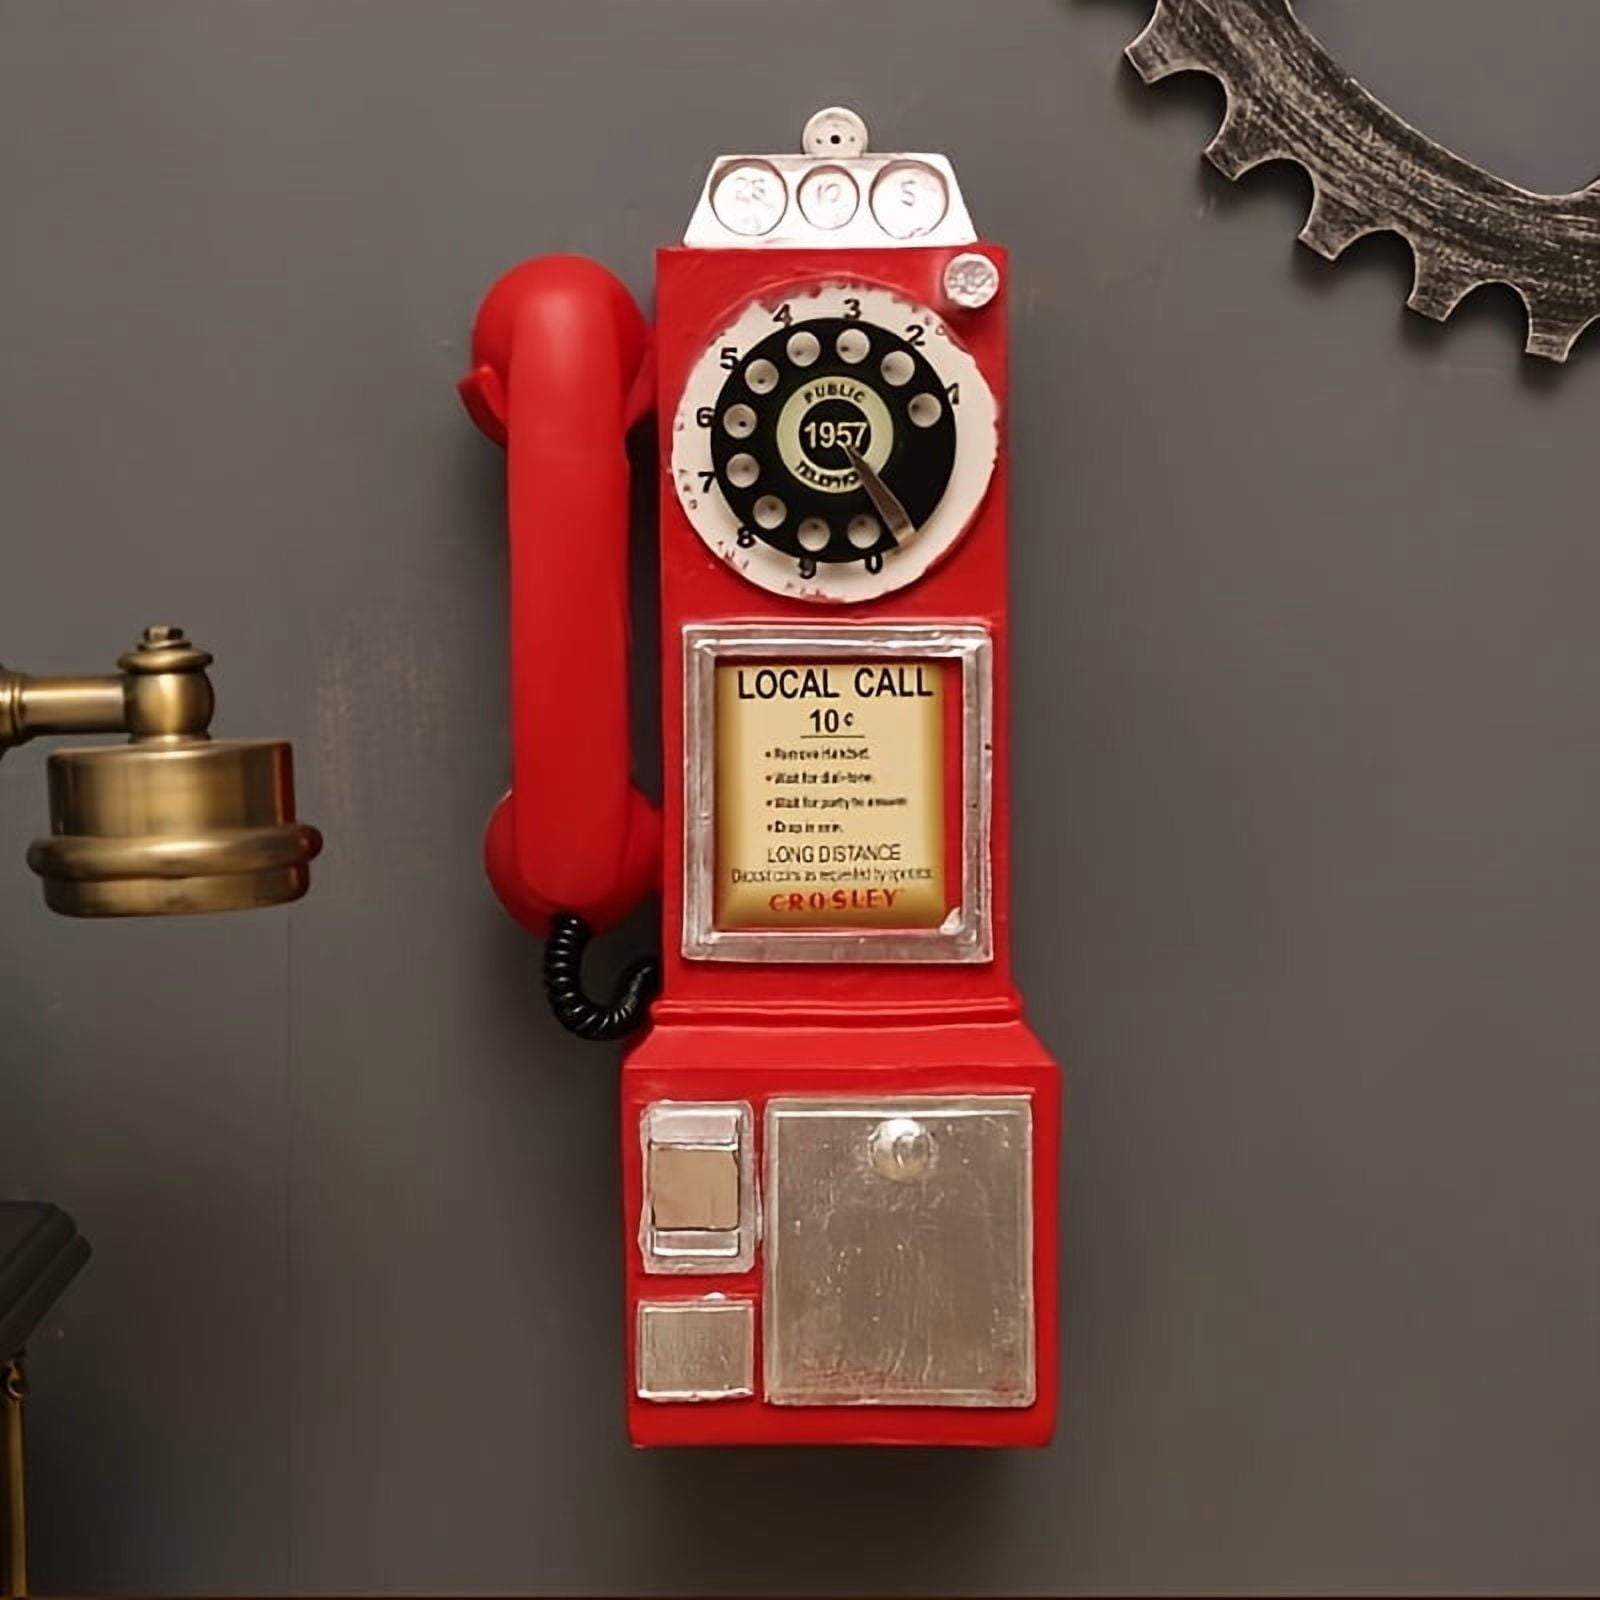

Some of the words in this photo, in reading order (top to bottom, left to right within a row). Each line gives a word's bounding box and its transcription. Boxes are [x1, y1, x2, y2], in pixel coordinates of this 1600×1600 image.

[773, 303, 793, 327] 4
[844, 298, 861, 320] 3
[905, 324, 925, 347] 2
[720, 347, 740, 370] 5
[803, 383, 866, 404] PUBLIC
[946, 383, 961, 405] 1
[696, 406, 715, 428] 6
[803, 421, 868, 449] 1957
[697, 471, 717, 494] 7
[736, 525, 756, 549] 8
[799, 557, 817, 579] 9
[864, 553, 883, 575] 0
[737, 668, 841, 699] LOCAL
[854, 667, 934, 697] CALL
[767, 845, 815, 864] LONG
[818, 843, 901, 863] DISTANCE
[768, 888, 898, 913] CROSLEY
